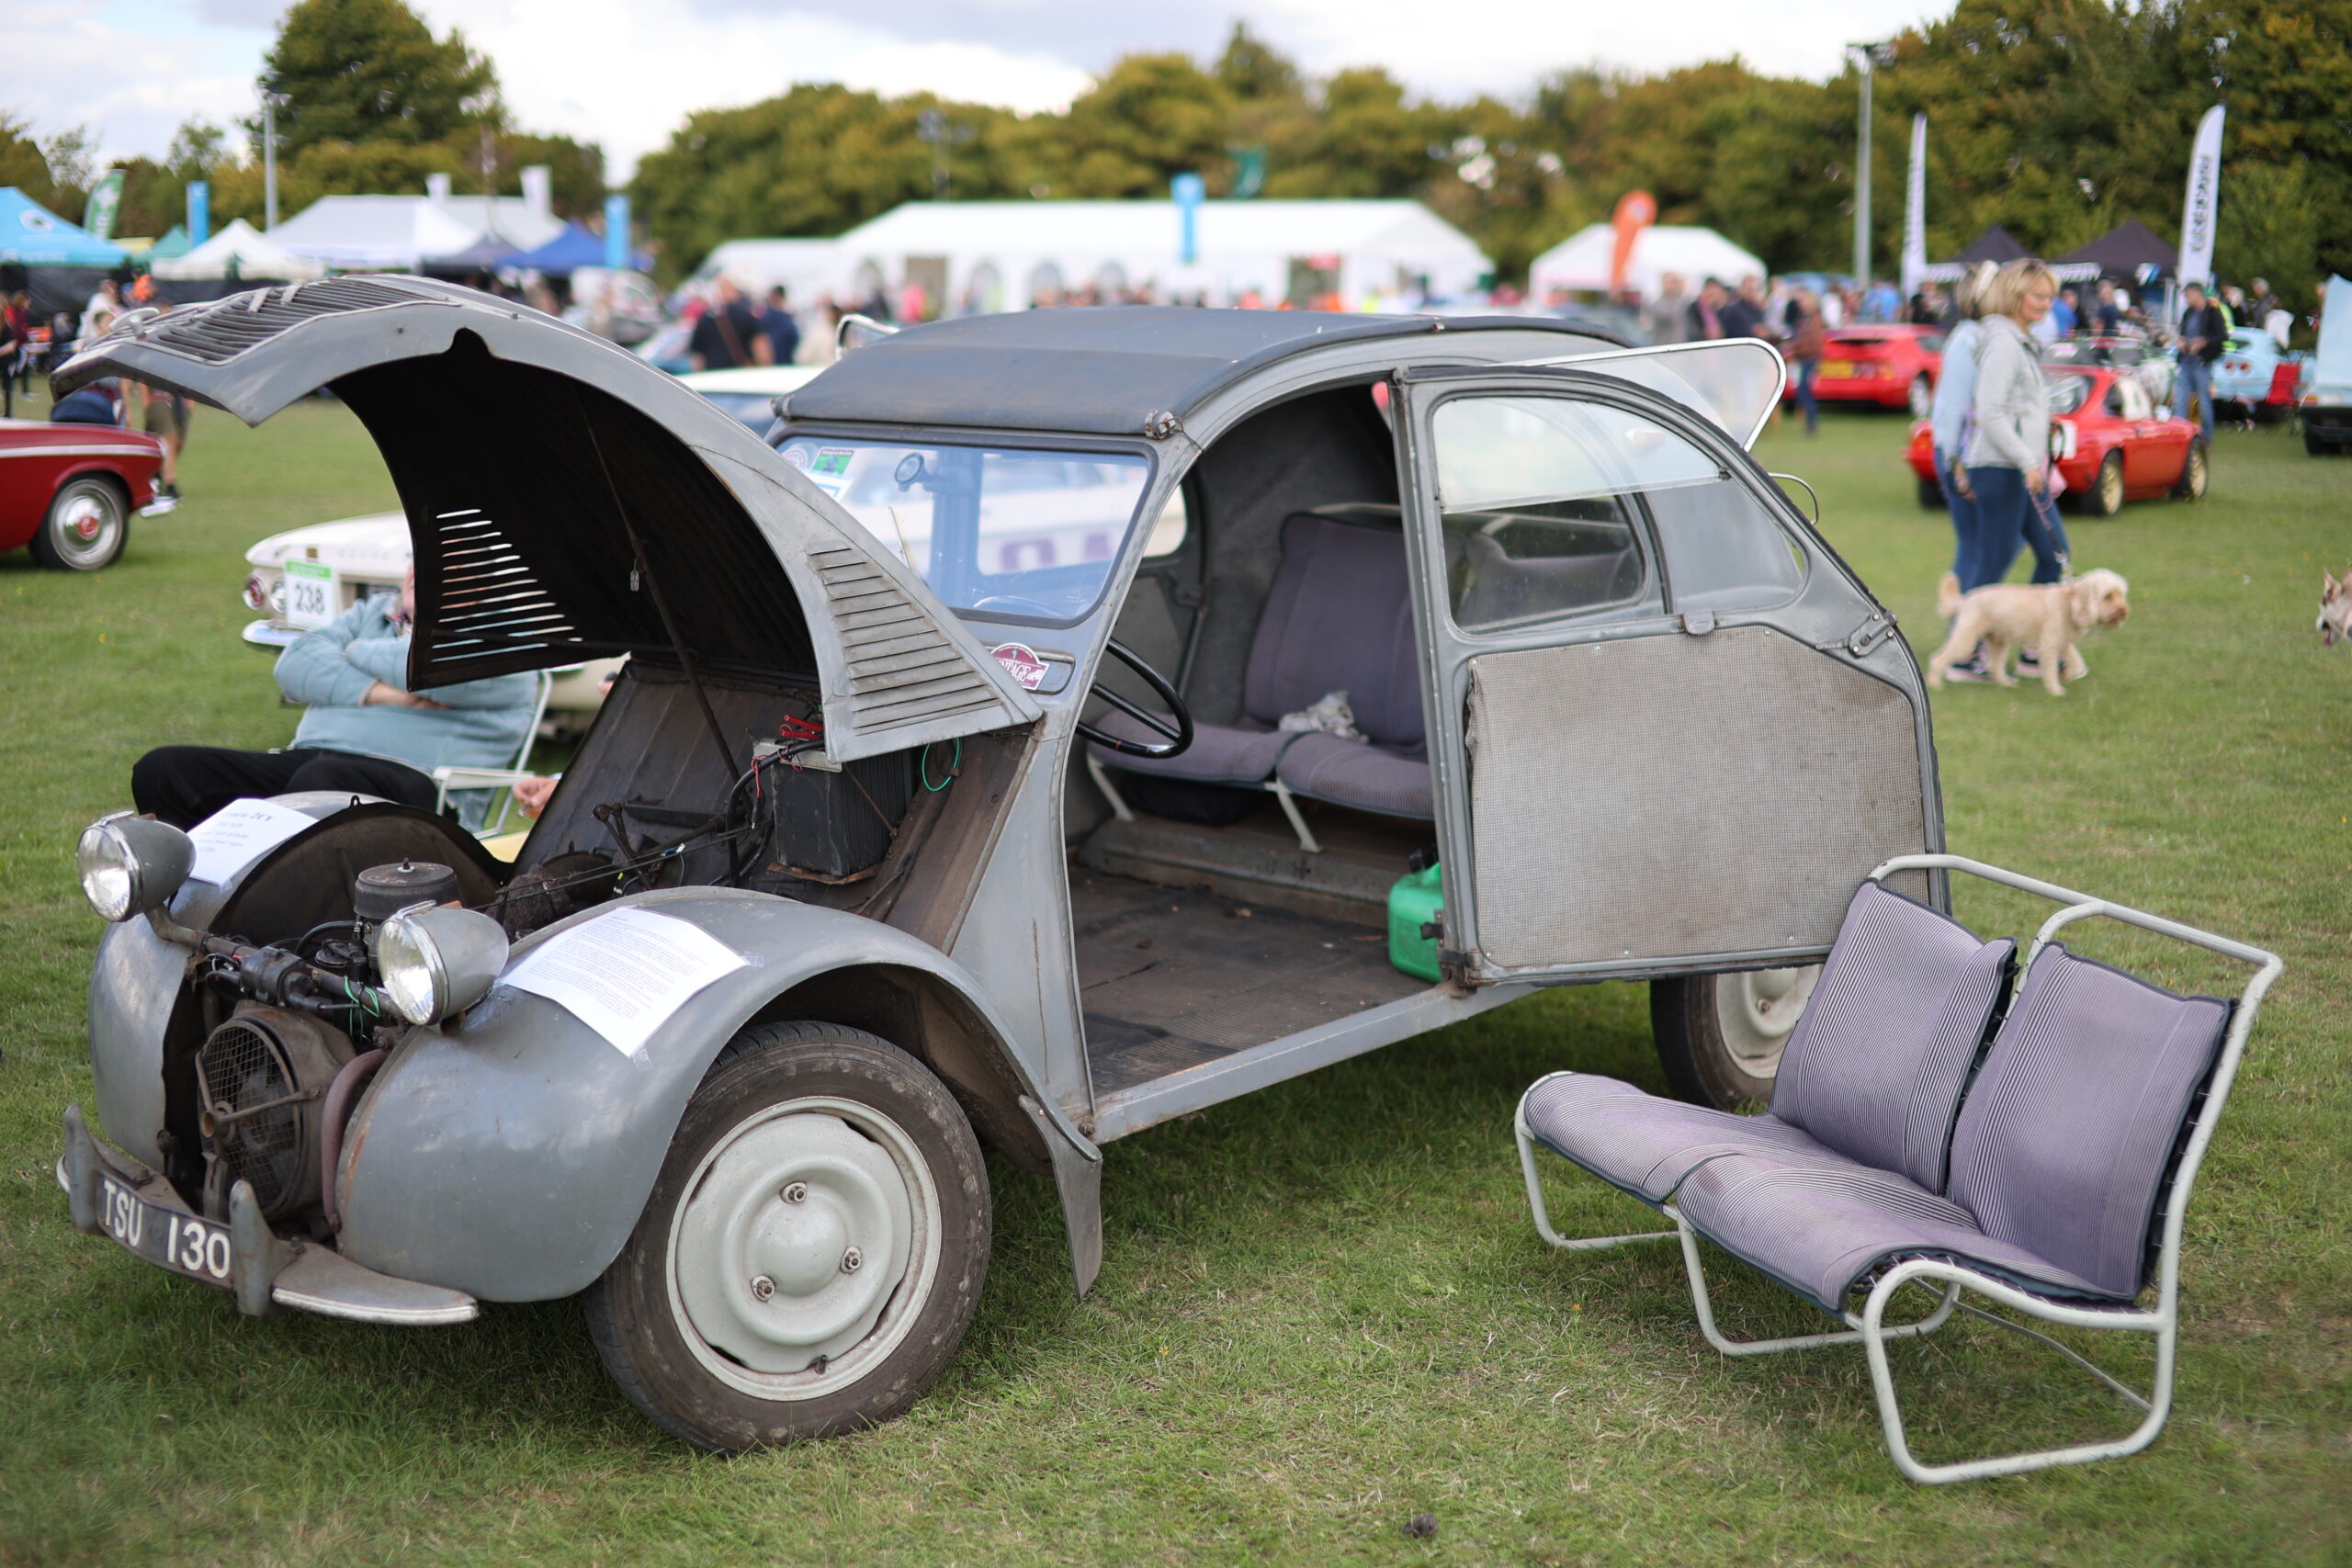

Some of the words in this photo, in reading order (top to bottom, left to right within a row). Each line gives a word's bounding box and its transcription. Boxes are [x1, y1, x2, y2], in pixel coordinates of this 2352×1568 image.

[296, 583, 324, 615] 238
[999, 660, 1031, 682] NTAGE
[103, 1179, 143, 1247] TSU
[167, 1215, 231, 1279] 130
